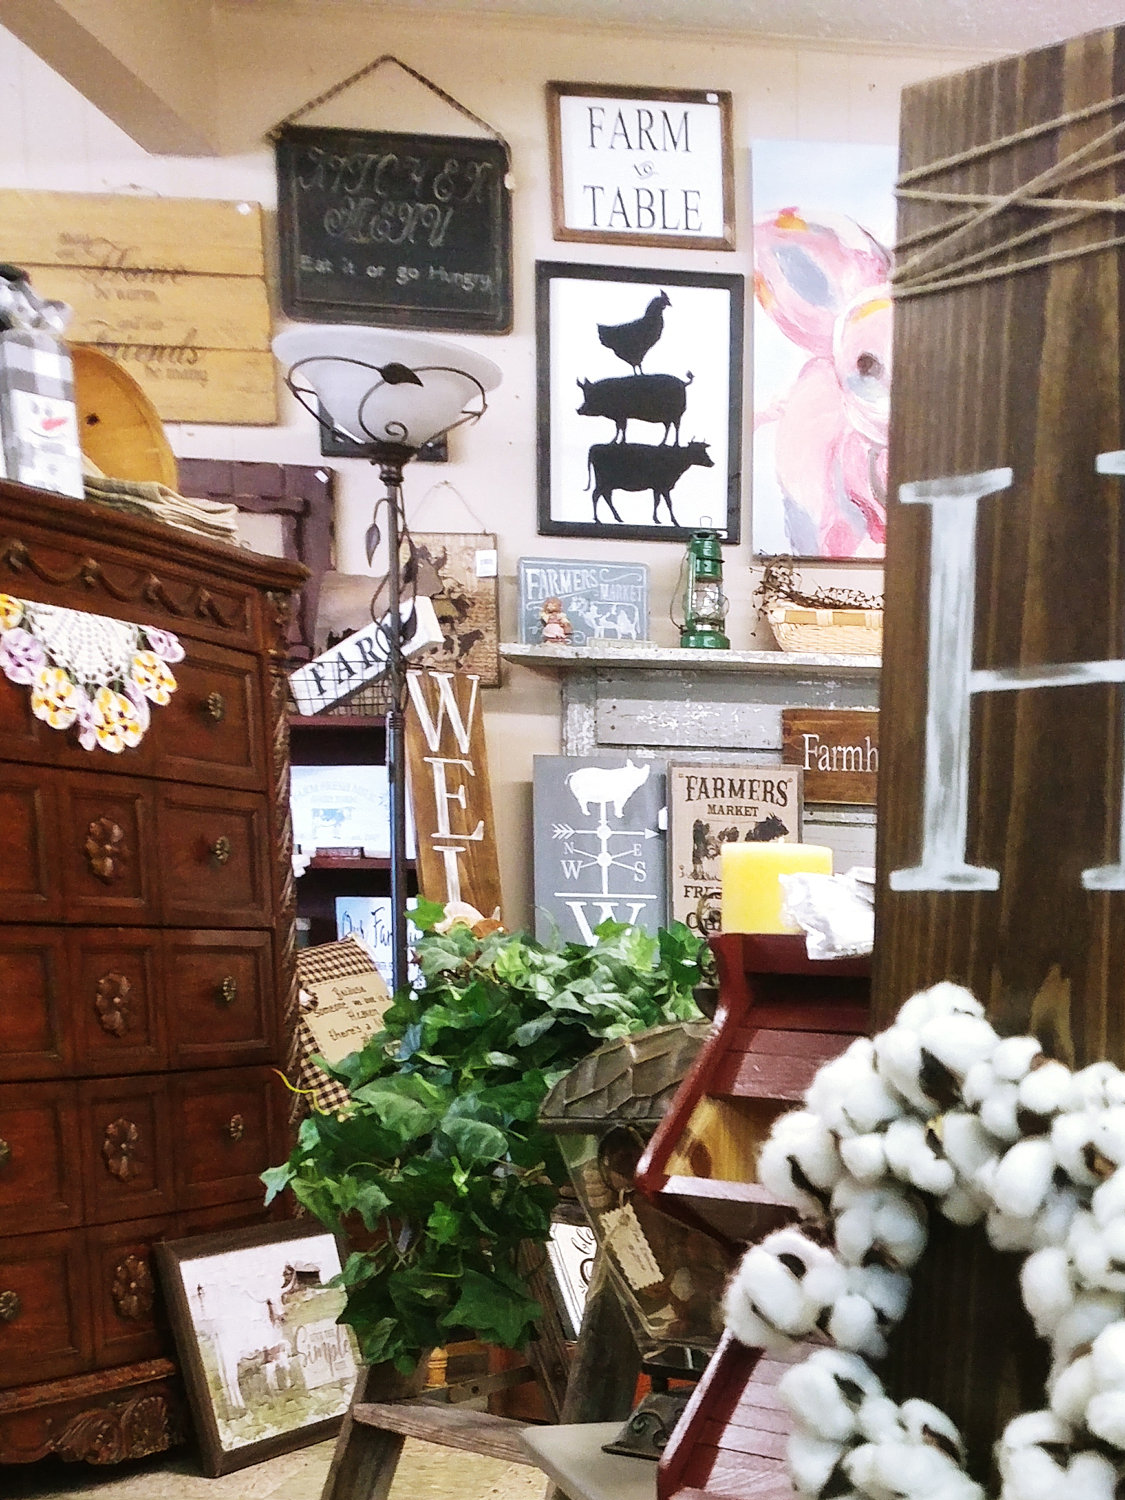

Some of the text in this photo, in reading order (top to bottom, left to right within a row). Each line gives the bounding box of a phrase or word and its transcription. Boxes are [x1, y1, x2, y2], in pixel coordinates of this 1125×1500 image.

[586, 106, 692, 152] FARM
[583, 185, 703, 232] TABLE
[525, 568, 600, 600] FARMERS
[684, 774, 790, 807] FARMERS
[707, 803, 759, 818] MARKET
[564, 841, 643, 856] N E
[560, 860, 648, 882] W S
